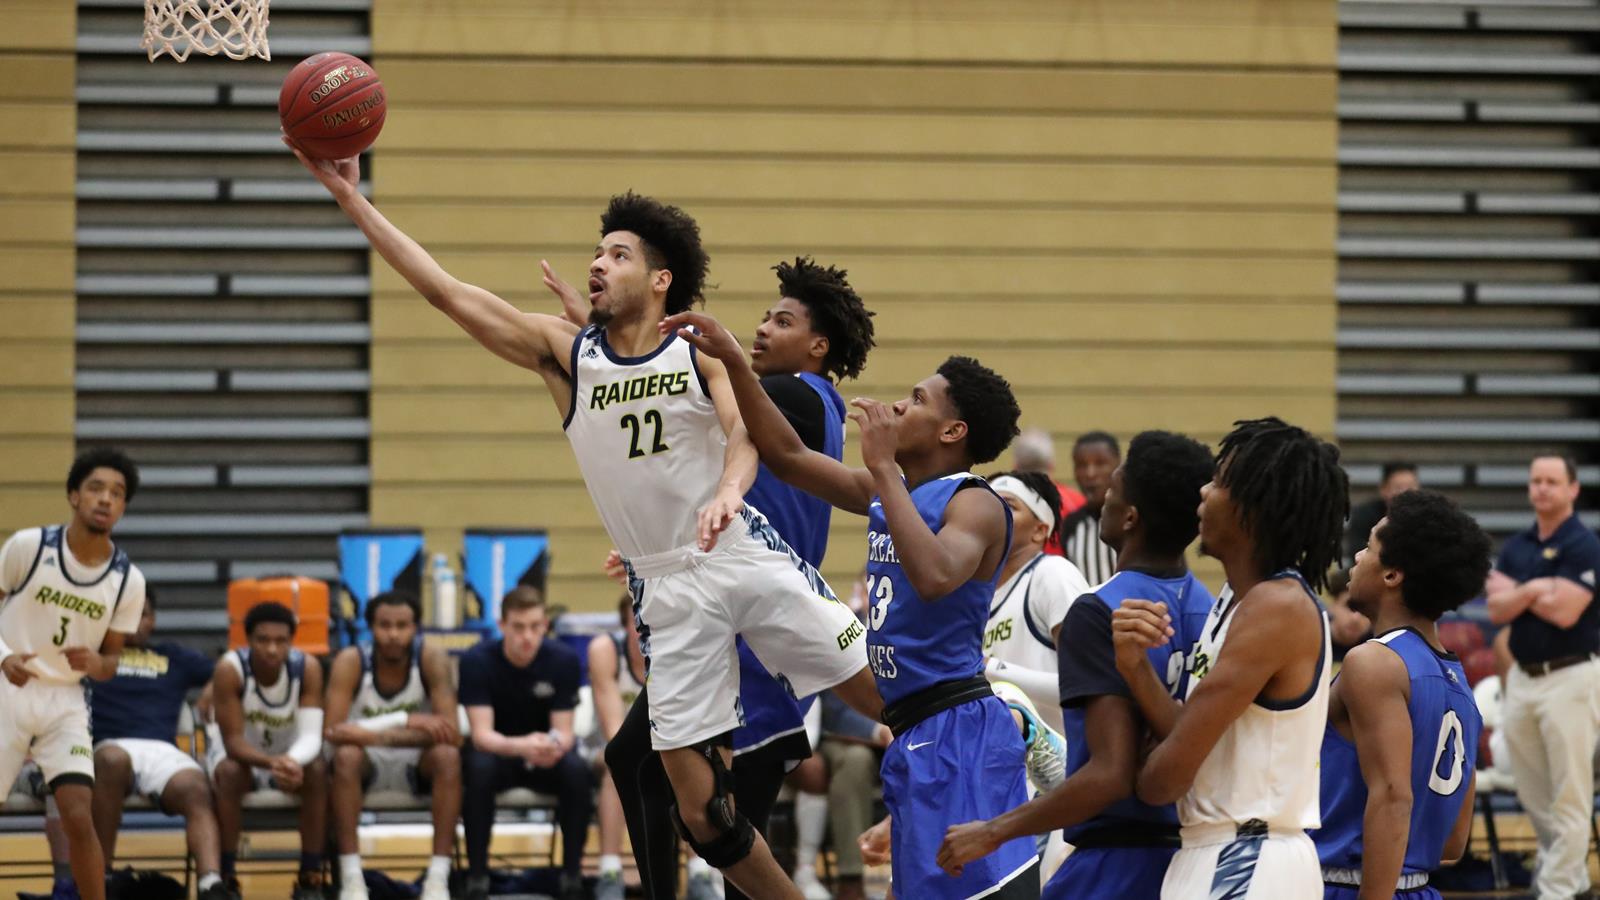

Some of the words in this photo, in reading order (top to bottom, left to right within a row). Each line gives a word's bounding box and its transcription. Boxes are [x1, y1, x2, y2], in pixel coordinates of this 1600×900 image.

[589, 371, 690, 411] RAIDERS
[619, 409, 670, 460] 22
[34, 584, 108, 621] RAIDERS
[52, 616, 72, 647] 3
[836, 619, 864, 651] GRCC
[1427, 709, 1466, 798] 0
